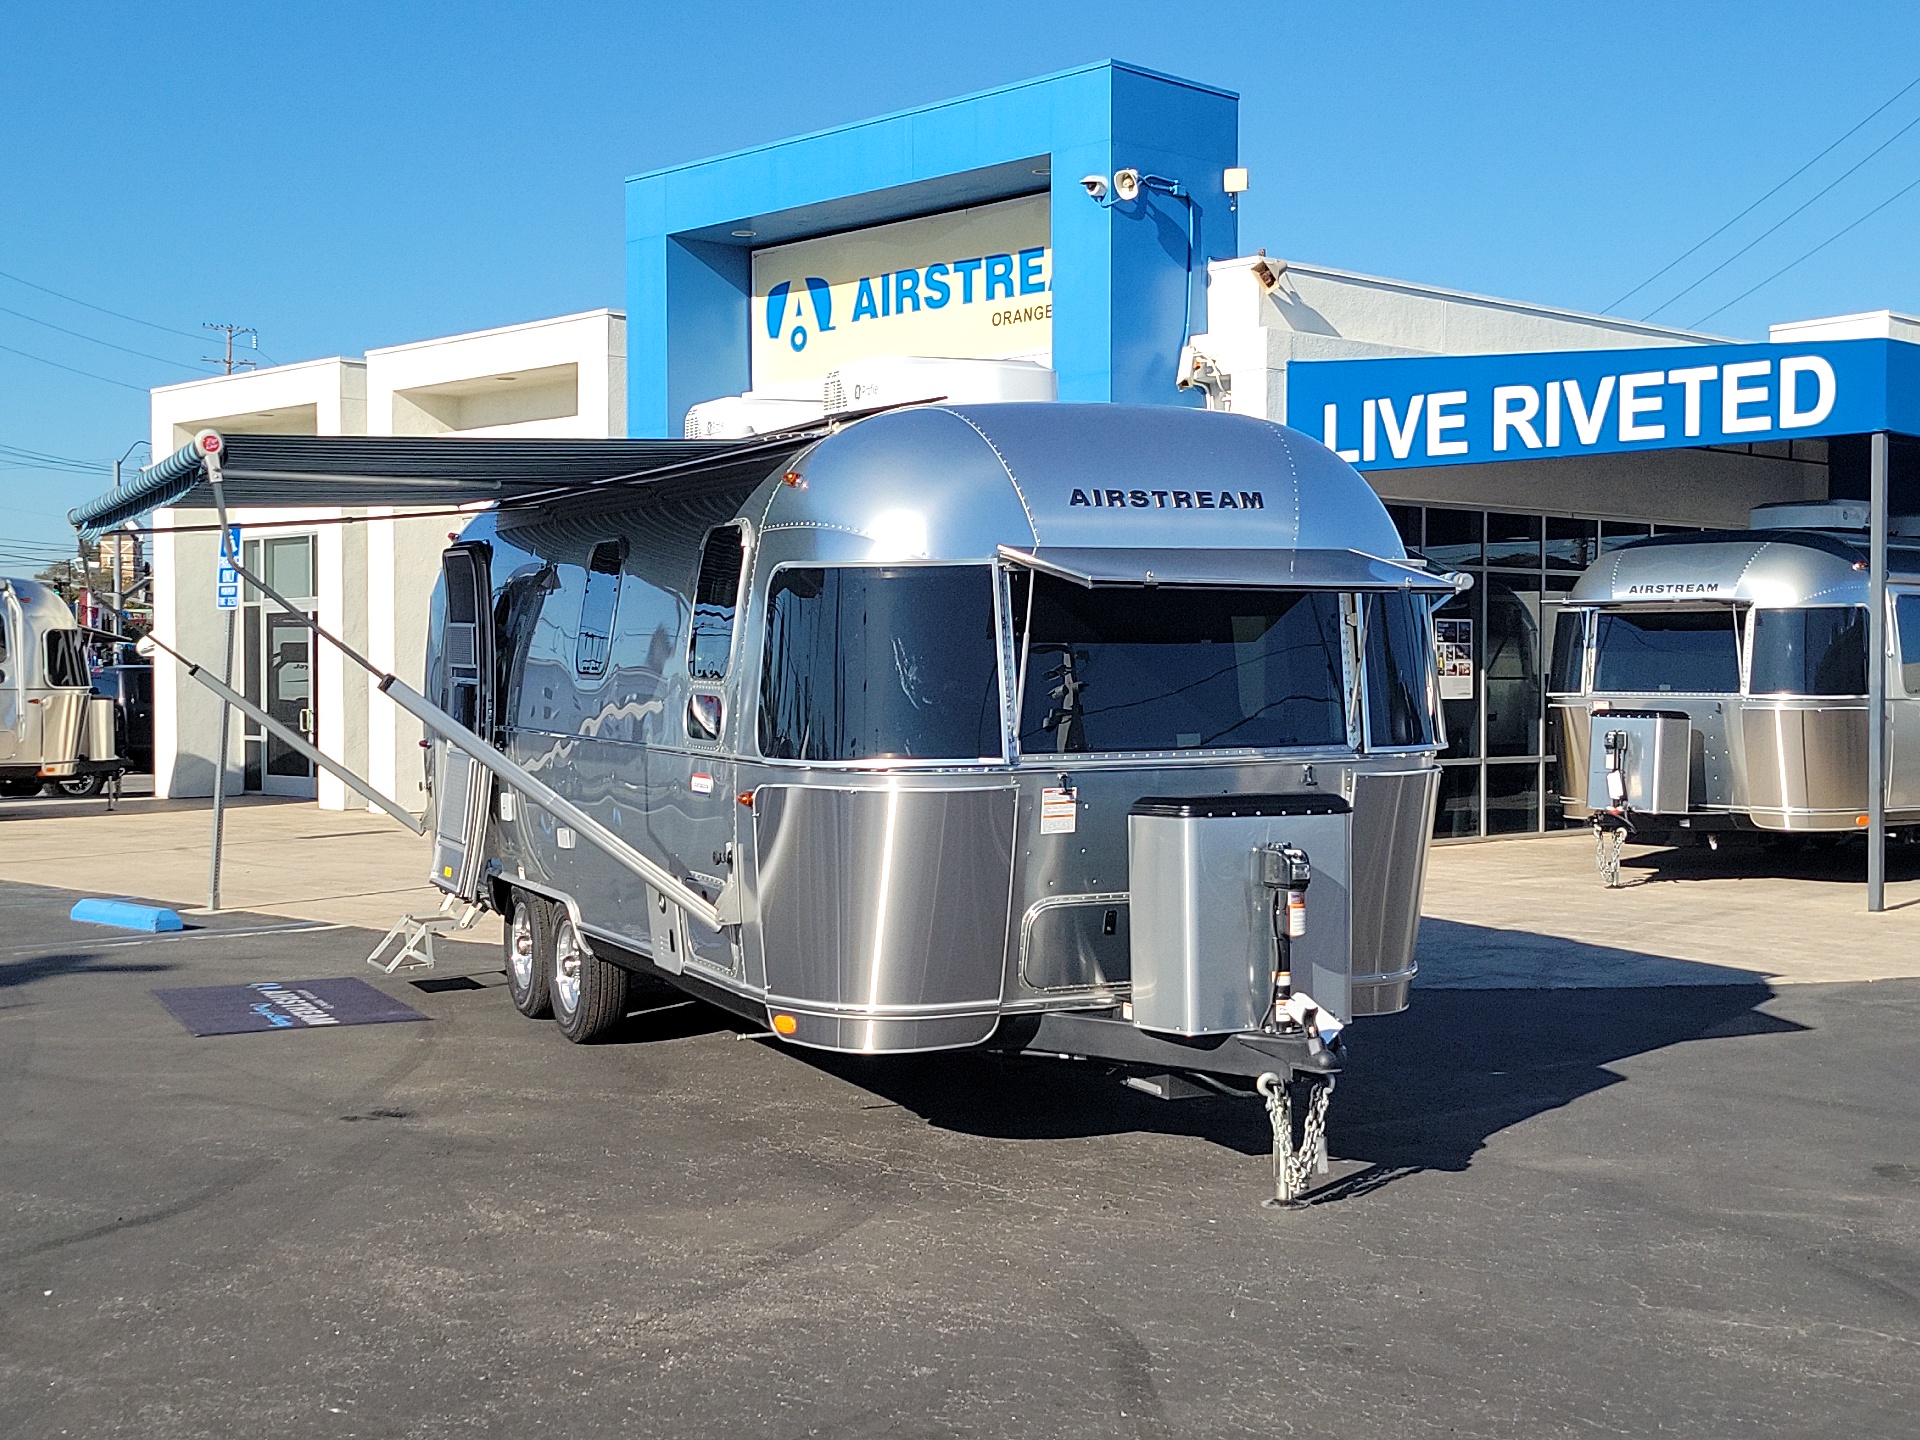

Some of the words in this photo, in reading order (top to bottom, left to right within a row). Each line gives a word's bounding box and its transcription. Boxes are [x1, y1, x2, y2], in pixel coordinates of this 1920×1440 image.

[851, 246, 1053, 323] AIRSTRE
[991, 303, 1053, 327] ORANGE
[1323, 390, 1469, 464] LIVE
[1492, 354, 1838, 452] RIVETED
[1069, 488, 1265, 510] AIRSTREAM
[1628, 583, 1720, 595] AIRSTREAM
